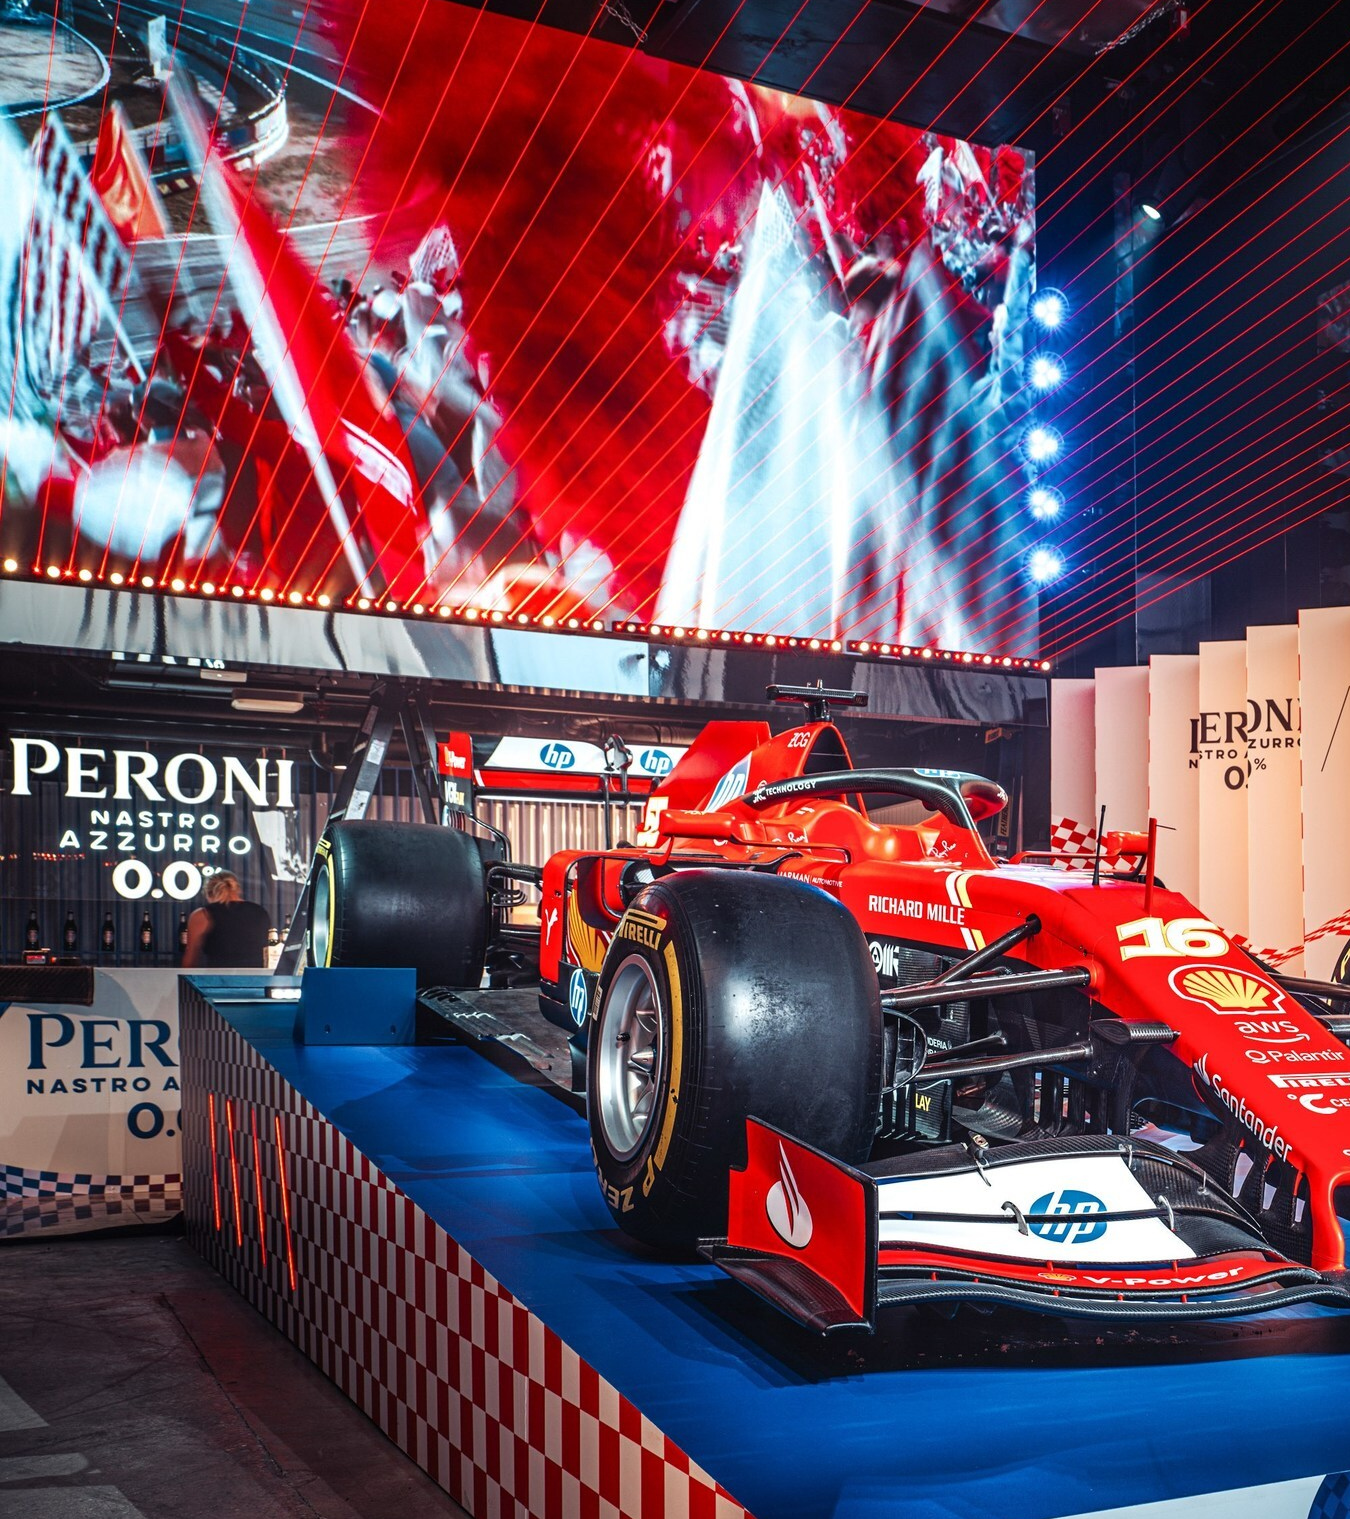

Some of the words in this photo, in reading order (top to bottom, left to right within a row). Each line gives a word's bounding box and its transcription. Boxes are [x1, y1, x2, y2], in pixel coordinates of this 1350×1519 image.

[540, 743, 575, 769] hp
[640, 749, 673, 775] hp
[10, 737, 294, 808] PERONI
[765, 780, 817, 797] TECHNOLOGY
[90, 810, 220, 830] NASTRO
[59, 829, 251, 855] AZZURRO
[868, 895, 923, 918] RICHARD
[926, 903, 965, 925] MILLE
[1115, 917, 1230, 962] 16
[1234, 1020, 1300, 1034] aws
[26, 1013, 181, 1070] PER
[1270, 1049, 1345, 1063] Palantir
[26, 1077, 151, 1095] NASTRO
[915, 1093, 931, 1112] LAY
[1212, 1073, 1294, 1163] Santander
[1029, 1189, 1108, 1244] hp
[1083, 1266, 1245, 1286] V-Power
